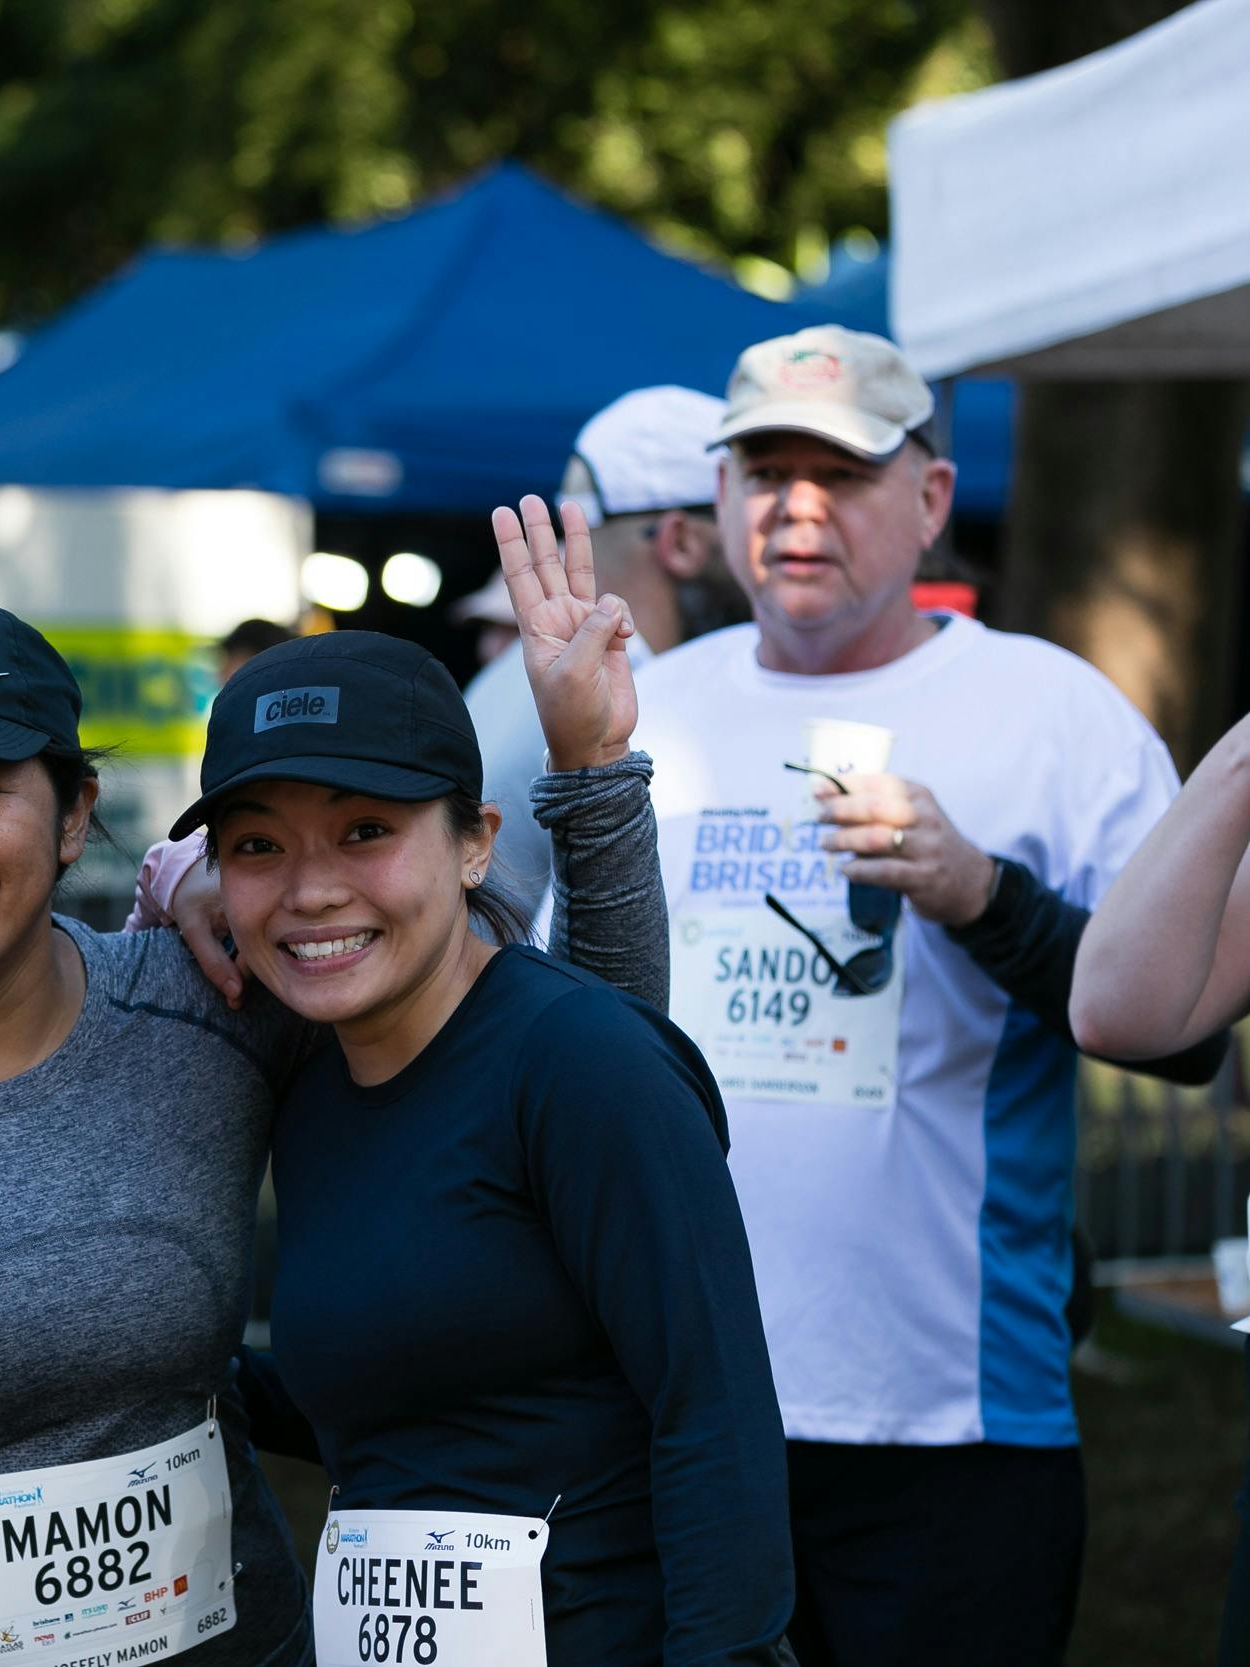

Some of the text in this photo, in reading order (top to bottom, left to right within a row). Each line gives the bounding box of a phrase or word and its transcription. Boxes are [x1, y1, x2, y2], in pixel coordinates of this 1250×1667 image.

[265, 692, 326, 722] ciele
[715, 945, 833, 986] SANDO
[727, 988, 811, 1026] 6149
[165, 1449, 201, 1471] 10km
[1, 1484, 172, 1563] MAMON
[465, 1533, 510, 1551] 10km
[35, 1540, 152, 1605] 6882
[337, 1556, 484, 1611] CHEENEE
[144, 1587, 168, 1603] BHP
[197, 1607, 228, 1634] 6882
[117, 1636, 168, 1663] MAMON
[358, 1613, 438, 1666] 6878
